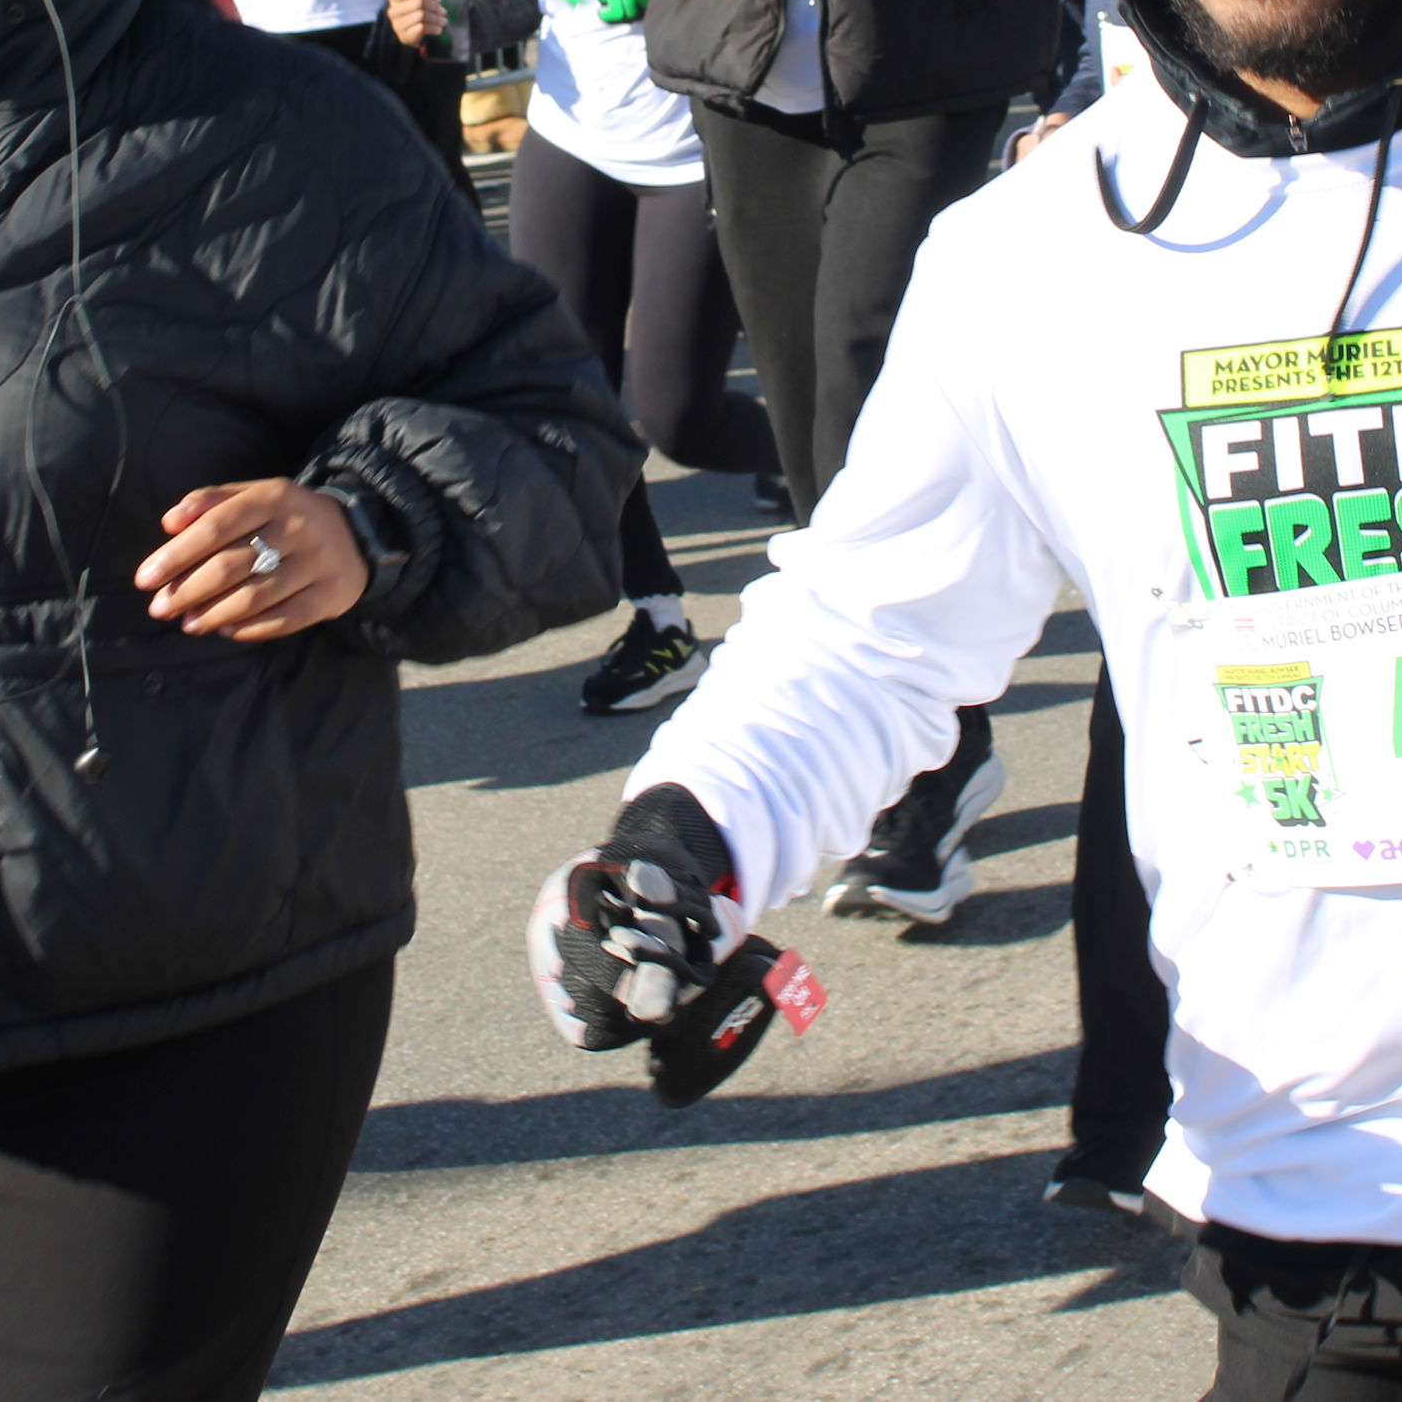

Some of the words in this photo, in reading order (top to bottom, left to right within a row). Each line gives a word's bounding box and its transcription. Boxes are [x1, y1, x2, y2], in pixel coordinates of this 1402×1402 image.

[1214, 350, 1299, 376] MAYOR
[1307, 339, 1400, 365] MURIEL
[1212, 369, 1316, 395] PRESENTS
[1262, 628, 1326, 650] MURIEL
[1223, 685, 1318, 713] FITDC
[1230, 710, 1317, 744] FRESH
[1239, 741, 1322, 778] START
[1262, 772, 1324, 824] 5K
[1283, 839, 1331, 858] DPR
